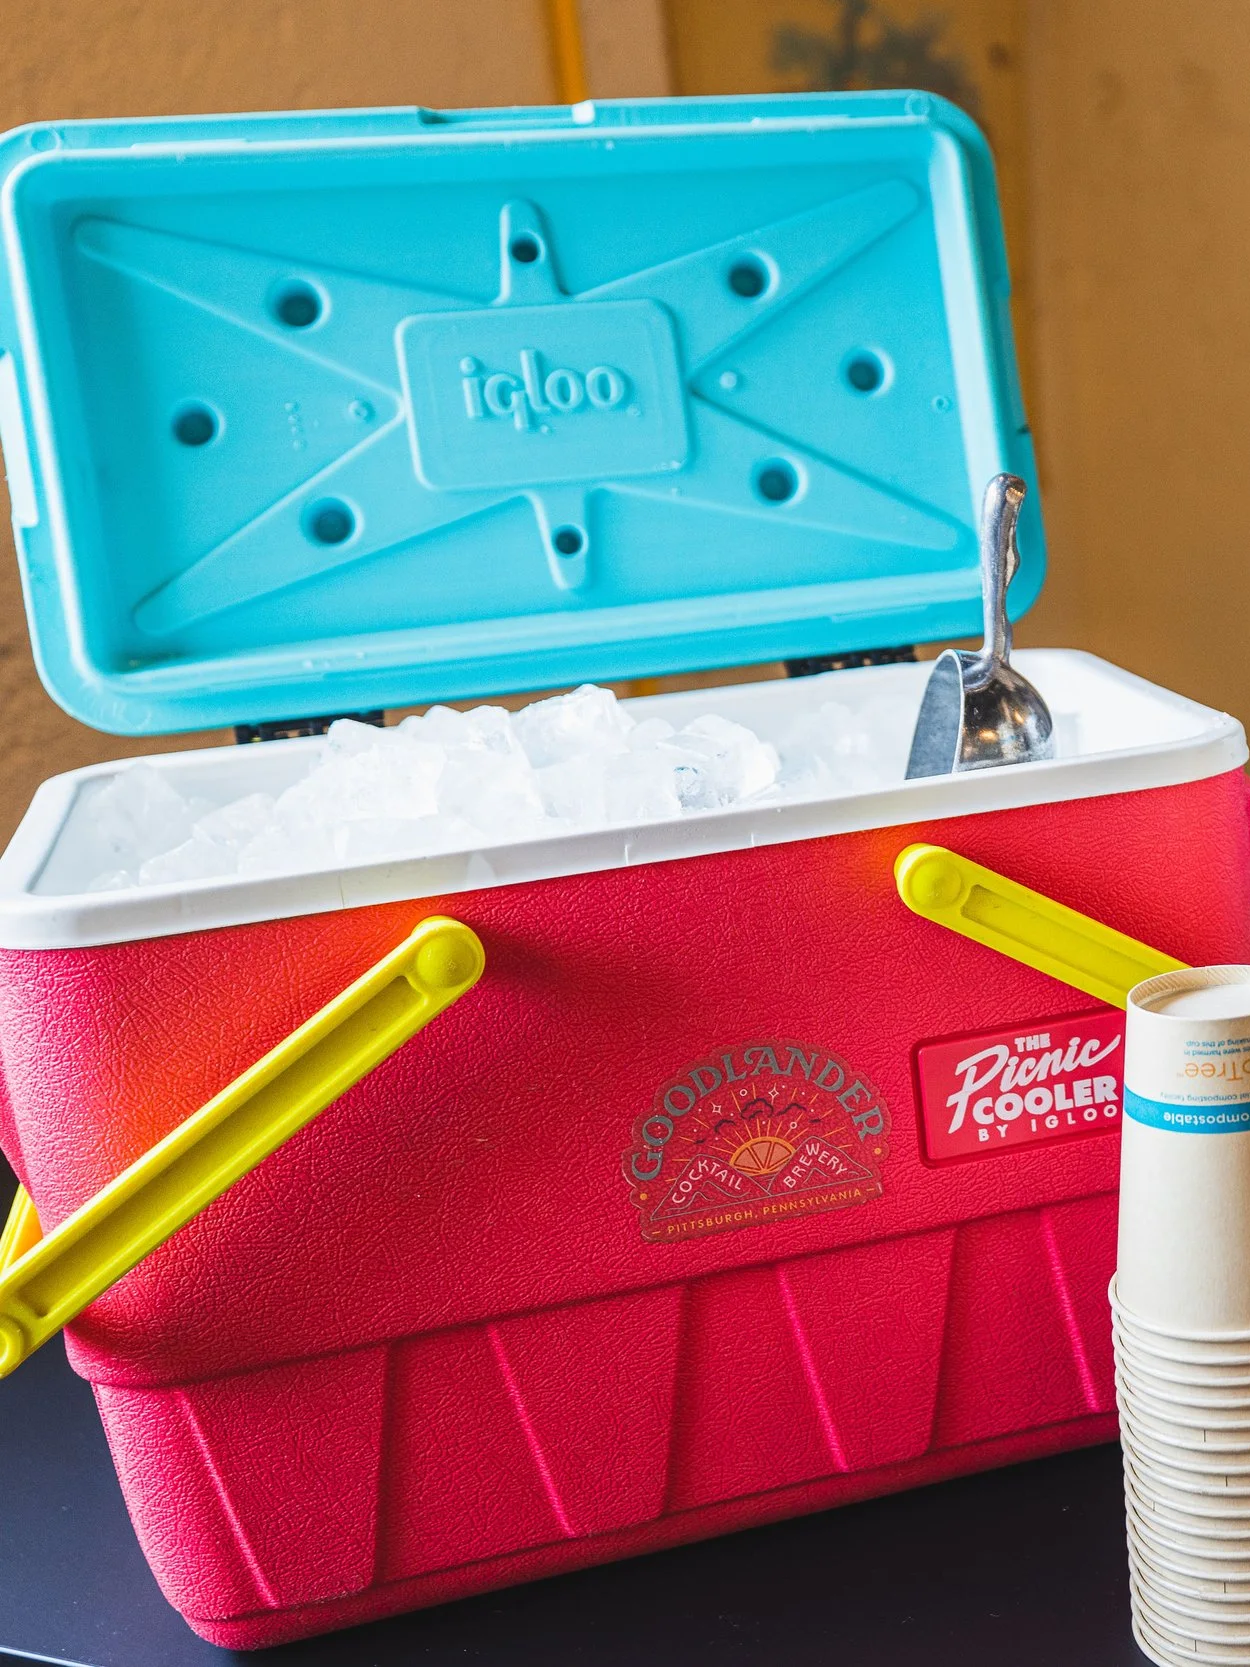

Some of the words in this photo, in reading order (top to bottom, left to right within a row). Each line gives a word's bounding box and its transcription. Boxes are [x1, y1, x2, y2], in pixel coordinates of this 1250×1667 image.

[459, 348, 628, 433] igloo
[1014, 1033, 1051, 1053] THE
[945, 1034, 1121, 1134] Picnic
[972, 1075, 1119, 1125] COOLER
[631, 1046, 885, 1182] GOODLANDER
[978, 1124, 1009, 1142] BY
[1031, 1104, 1118, 1132] IGLOO
[672, 1159, 743, 1205] COCKTAIL
[783, 1142, 848, 1189] BREWERY
[667, 1209, 758, 1234] PITTSBURGH,
[762, 1188, 862, 1216] PENNSYLVANIA
